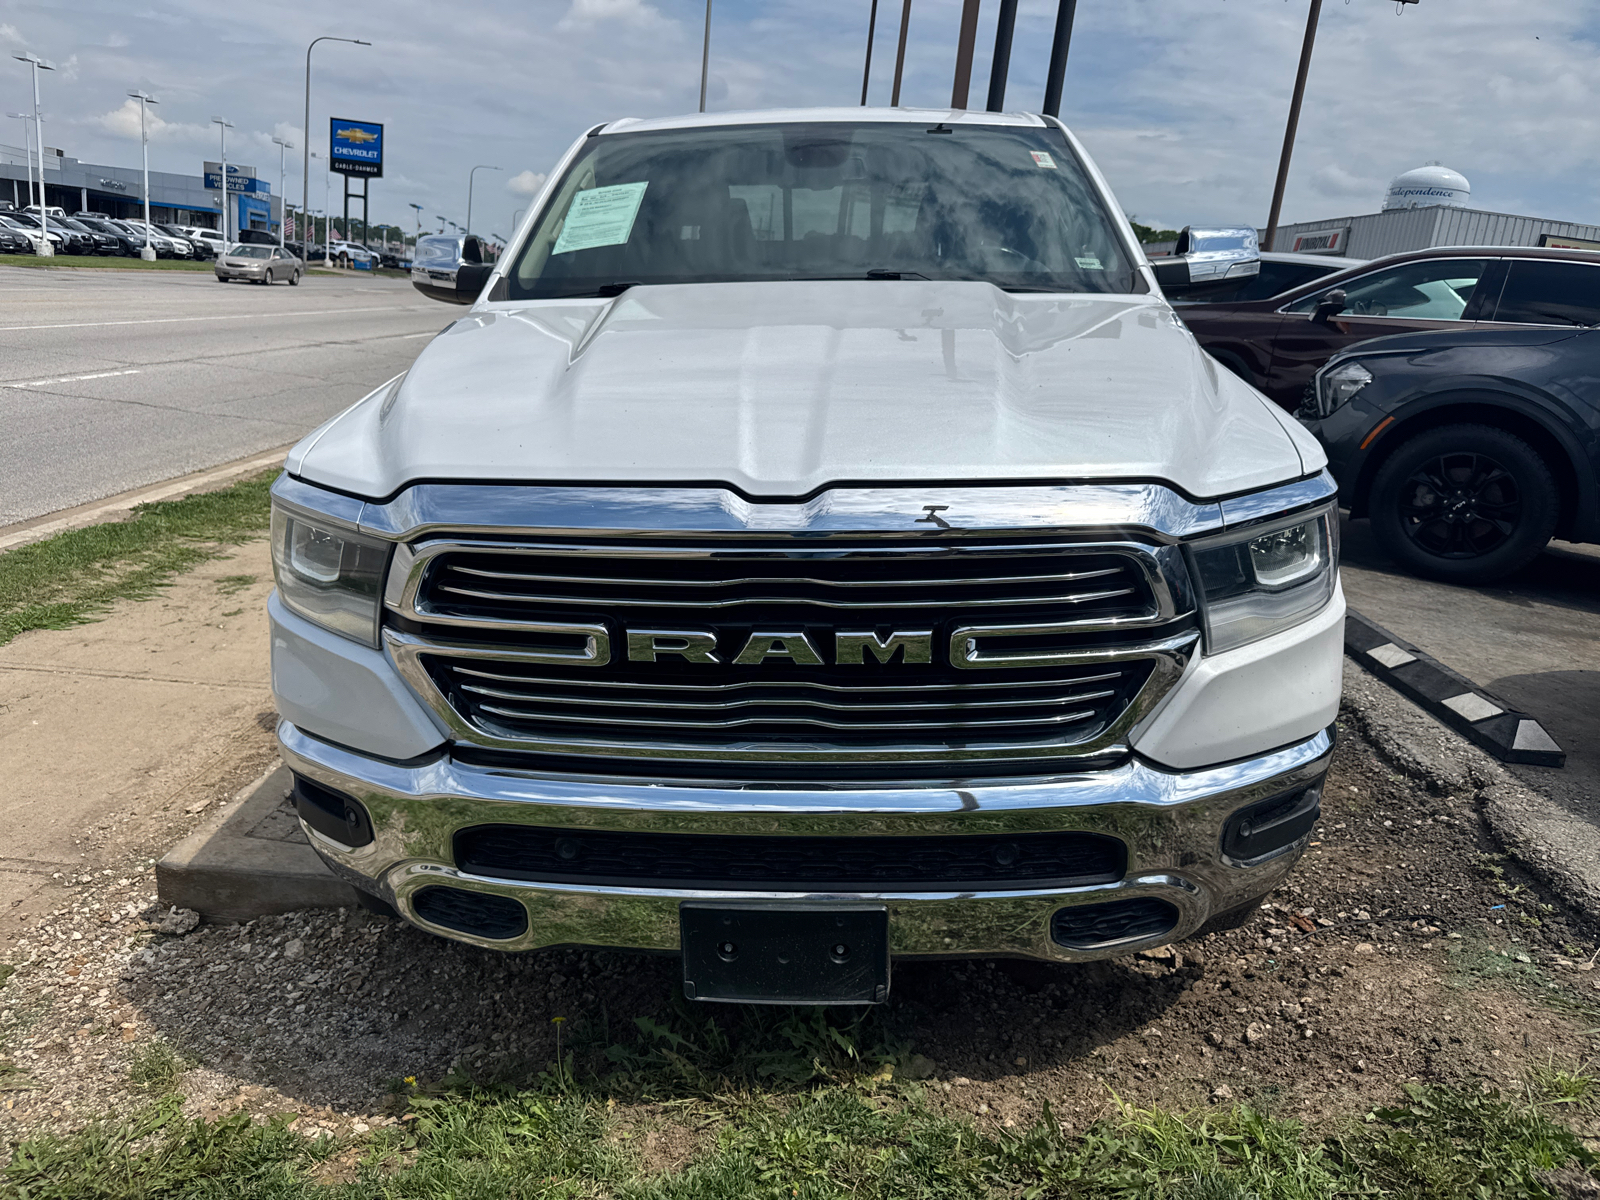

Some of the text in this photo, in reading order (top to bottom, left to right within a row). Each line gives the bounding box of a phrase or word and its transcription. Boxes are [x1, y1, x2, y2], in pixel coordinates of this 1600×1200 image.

[334, 146, 378, 159] CHEVROLET
[213, 181, 245, 191] VEICLES
[626, 629, 934, 665] RAM
